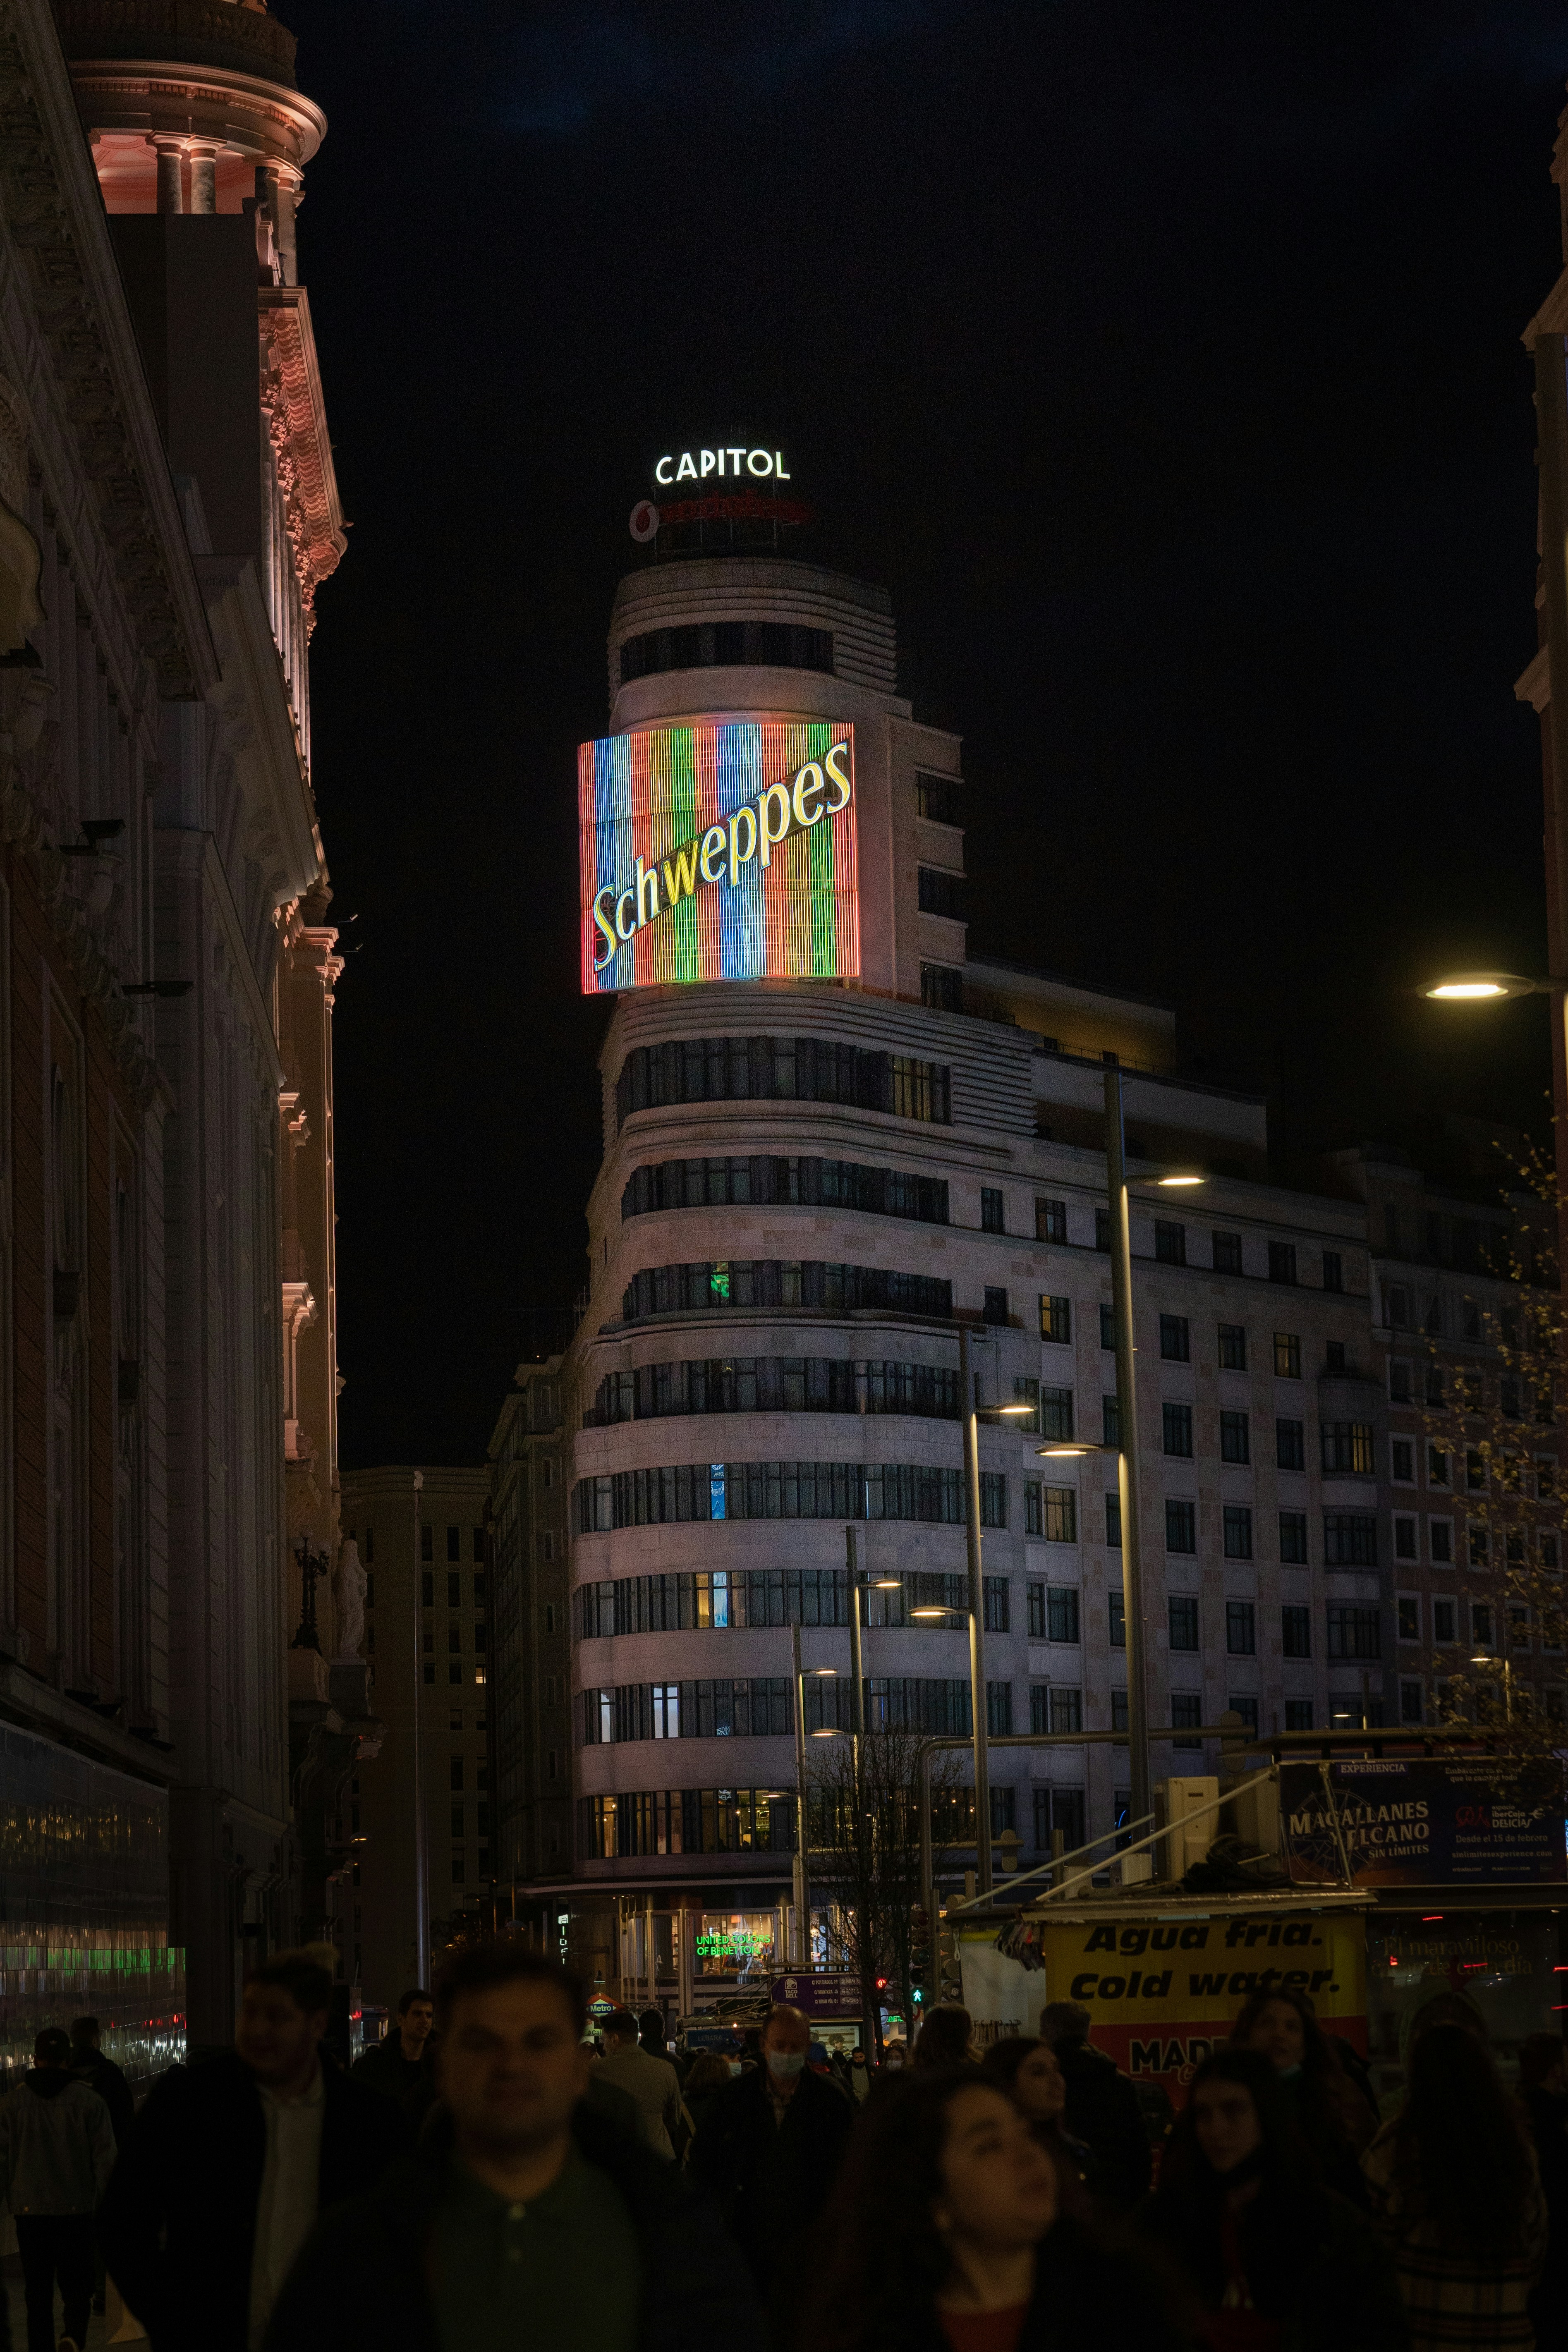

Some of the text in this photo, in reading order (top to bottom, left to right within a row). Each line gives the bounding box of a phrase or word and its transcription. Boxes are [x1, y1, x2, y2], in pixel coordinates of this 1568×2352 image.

[656, 449, 790, 484] CAPITOL
[593, 742, 851, 971] Schweppes
[1341, 1763, 1406, 1773] EXPERIENCIA
[1289, 1801, 1429, 1835] MAGALLANES
[1492, 1818, 1533, 1828] DELICIAS
[1346, 1822, 1429, 1851] ELCANO
[1455, 1834, 1482, 1843] Desde
[1494, 1834, 1503, 1842] 15
[1517, 1834, 1548, 1842] febrero
[1368, 1844, 1429, 1859] SIN LÍMITES
[1451, 1850, 1552, 1859] sinlimitesexperience.com
[696, 1935, 771, 1945] UNITED COLORS
[1084, 1918, 1322, 1956] Agua fría.
[1410, 1935, 1520, 1955] maravilloso
[697, 1946, 709, 1956] OF
[1429, 1956, 1451, 1975] de
[1070, 1970, 1173, 2000] Cold
[1190, 1967, 1341, 1996] water.
[1129, 2035, 1230, 2075] MAD
